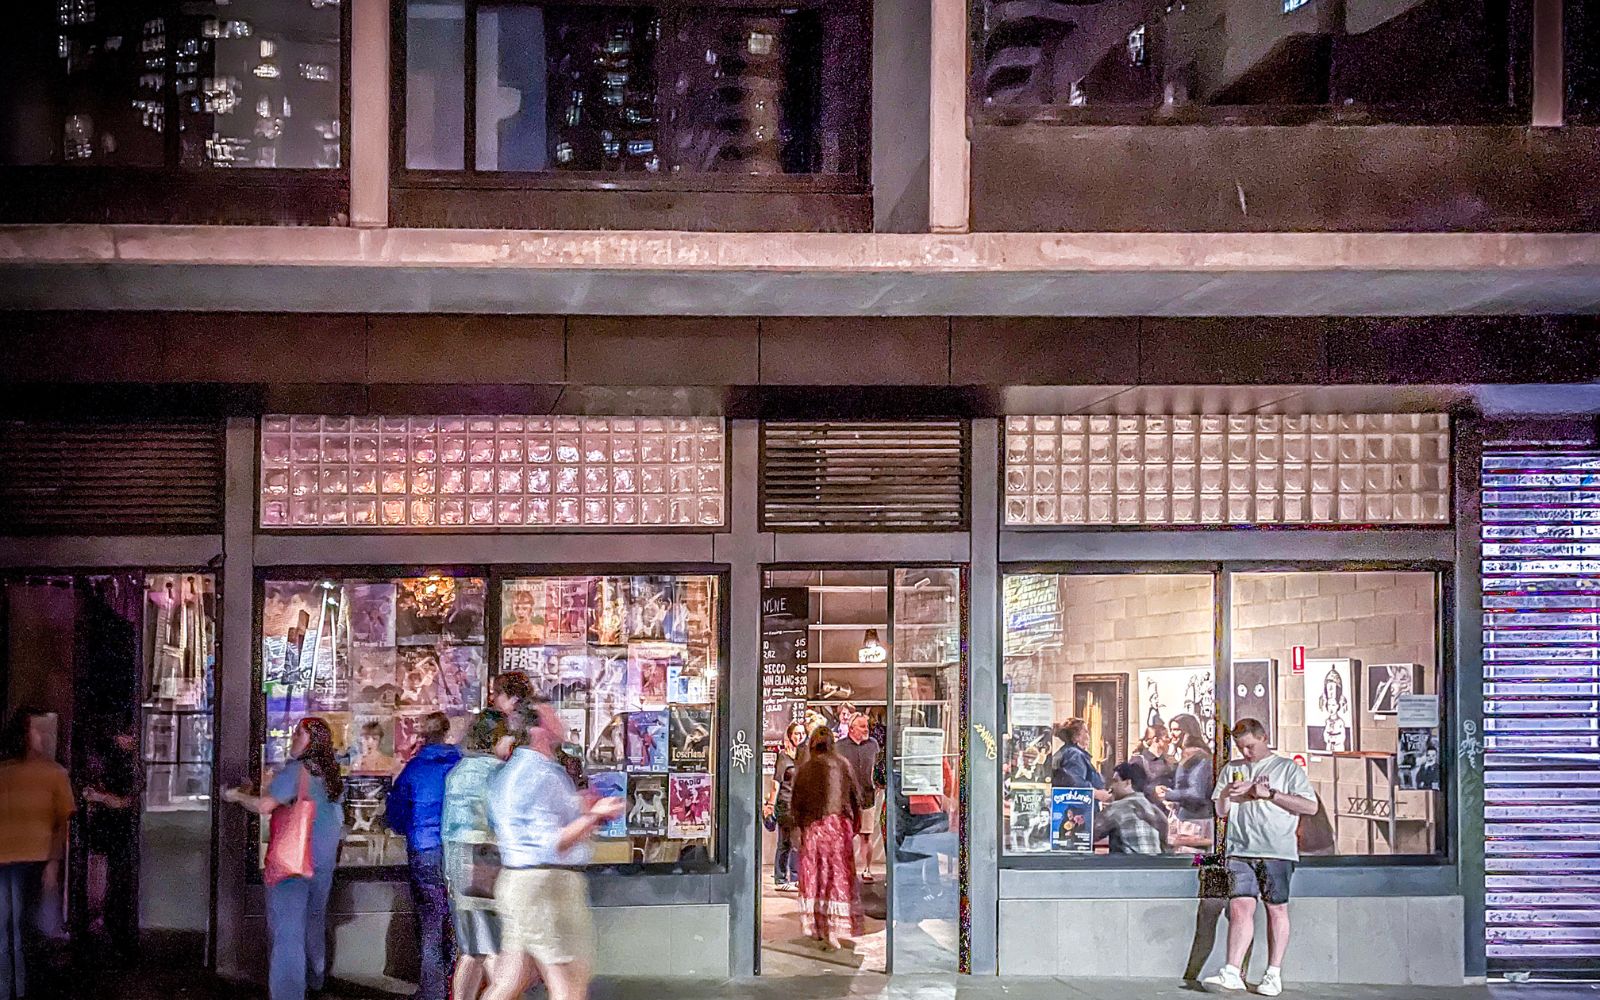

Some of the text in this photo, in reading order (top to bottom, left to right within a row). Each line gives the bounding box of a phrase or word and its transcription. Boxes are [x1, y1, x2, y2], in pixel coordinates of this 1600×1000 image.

[794, 638, 807, 648] $15
[503, 647, 544, 658] BEAST
[795, 650, 808, 659] $15
[503, 657, 543, 670] FEAST
[763, 663, 808, 674] SECCO $15
[775, 675, 794, 686] BLANC
[794, 675, 808, 686] $20
[794, 686, 807, 696] $20
[679, 777, 701, 786] RADIO
